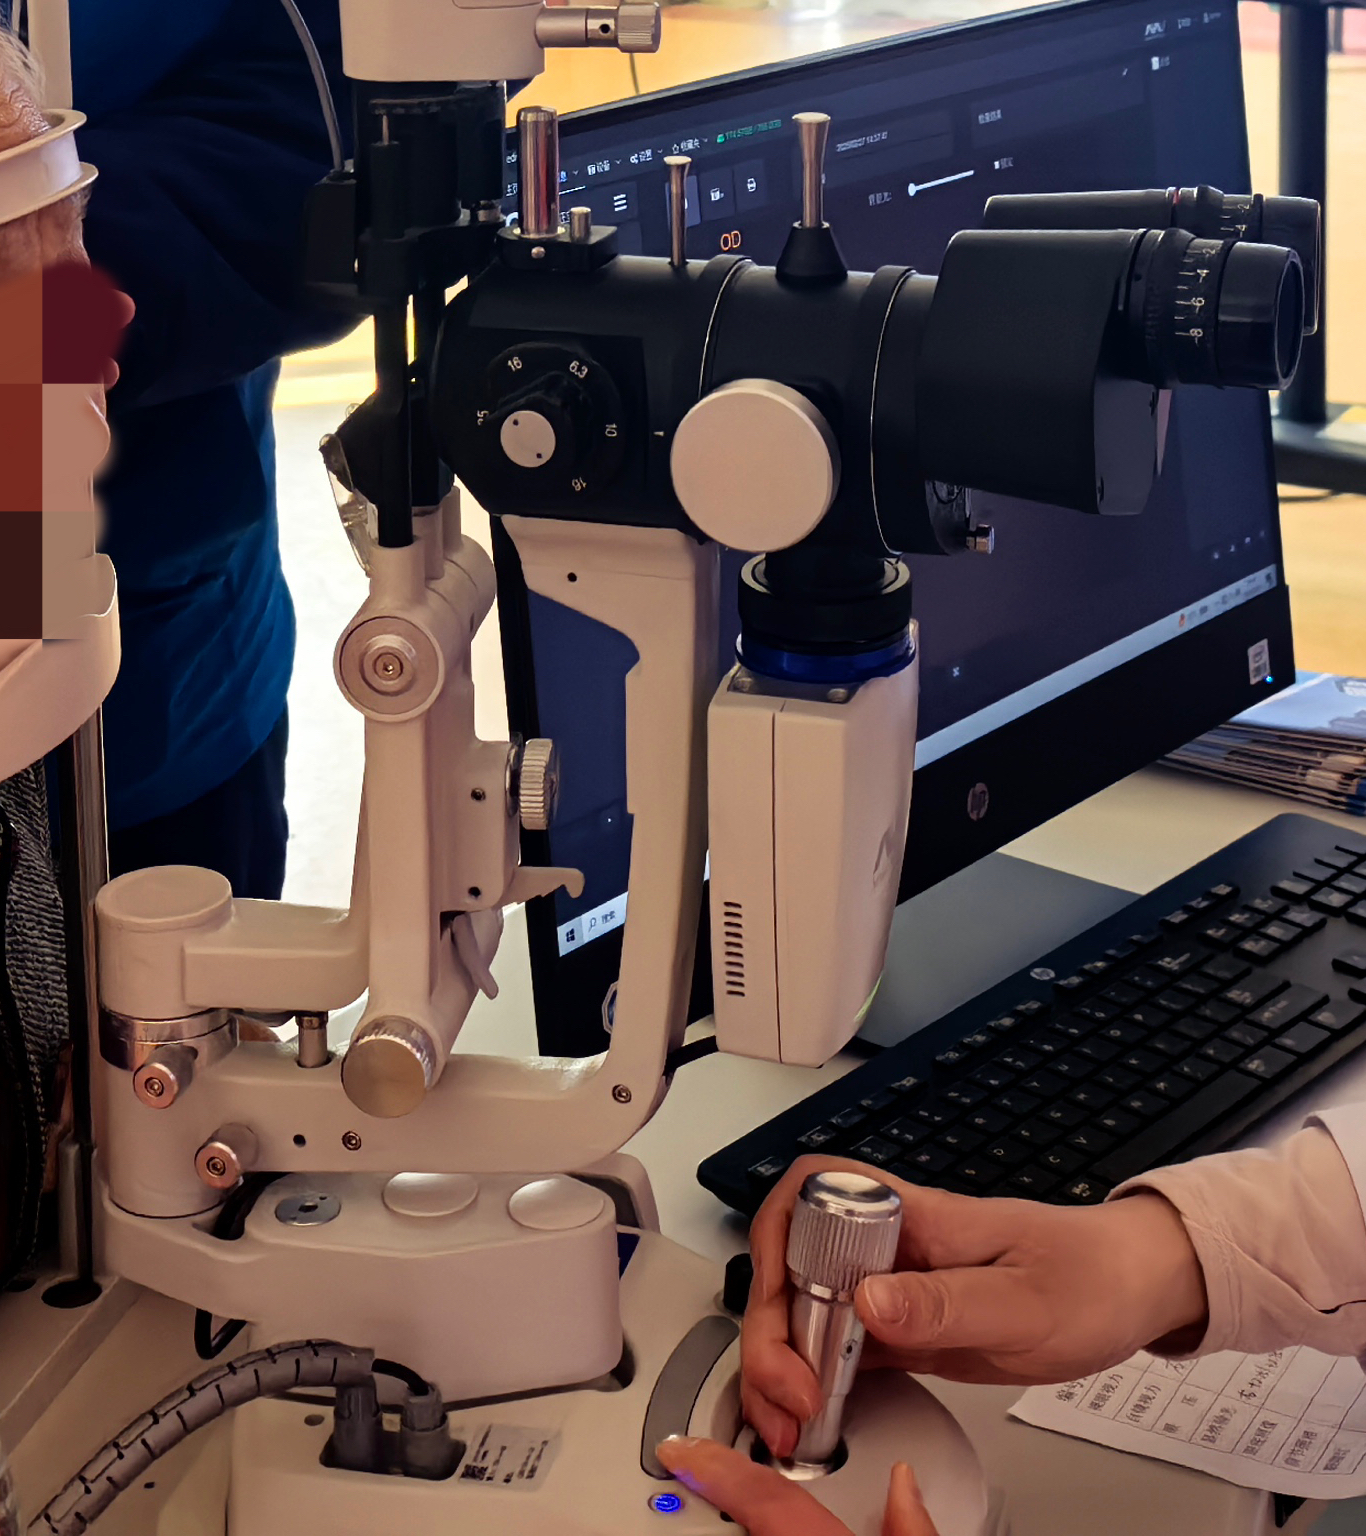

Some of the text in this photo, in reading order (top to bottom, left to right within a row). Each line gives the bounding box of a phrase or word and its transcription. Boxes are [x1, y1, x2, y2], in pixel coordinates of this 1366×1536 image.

[720, 230, 741, 251] OD
[569, 360, 588, 379] 6.3
[604, 422, 618, 438] 10
